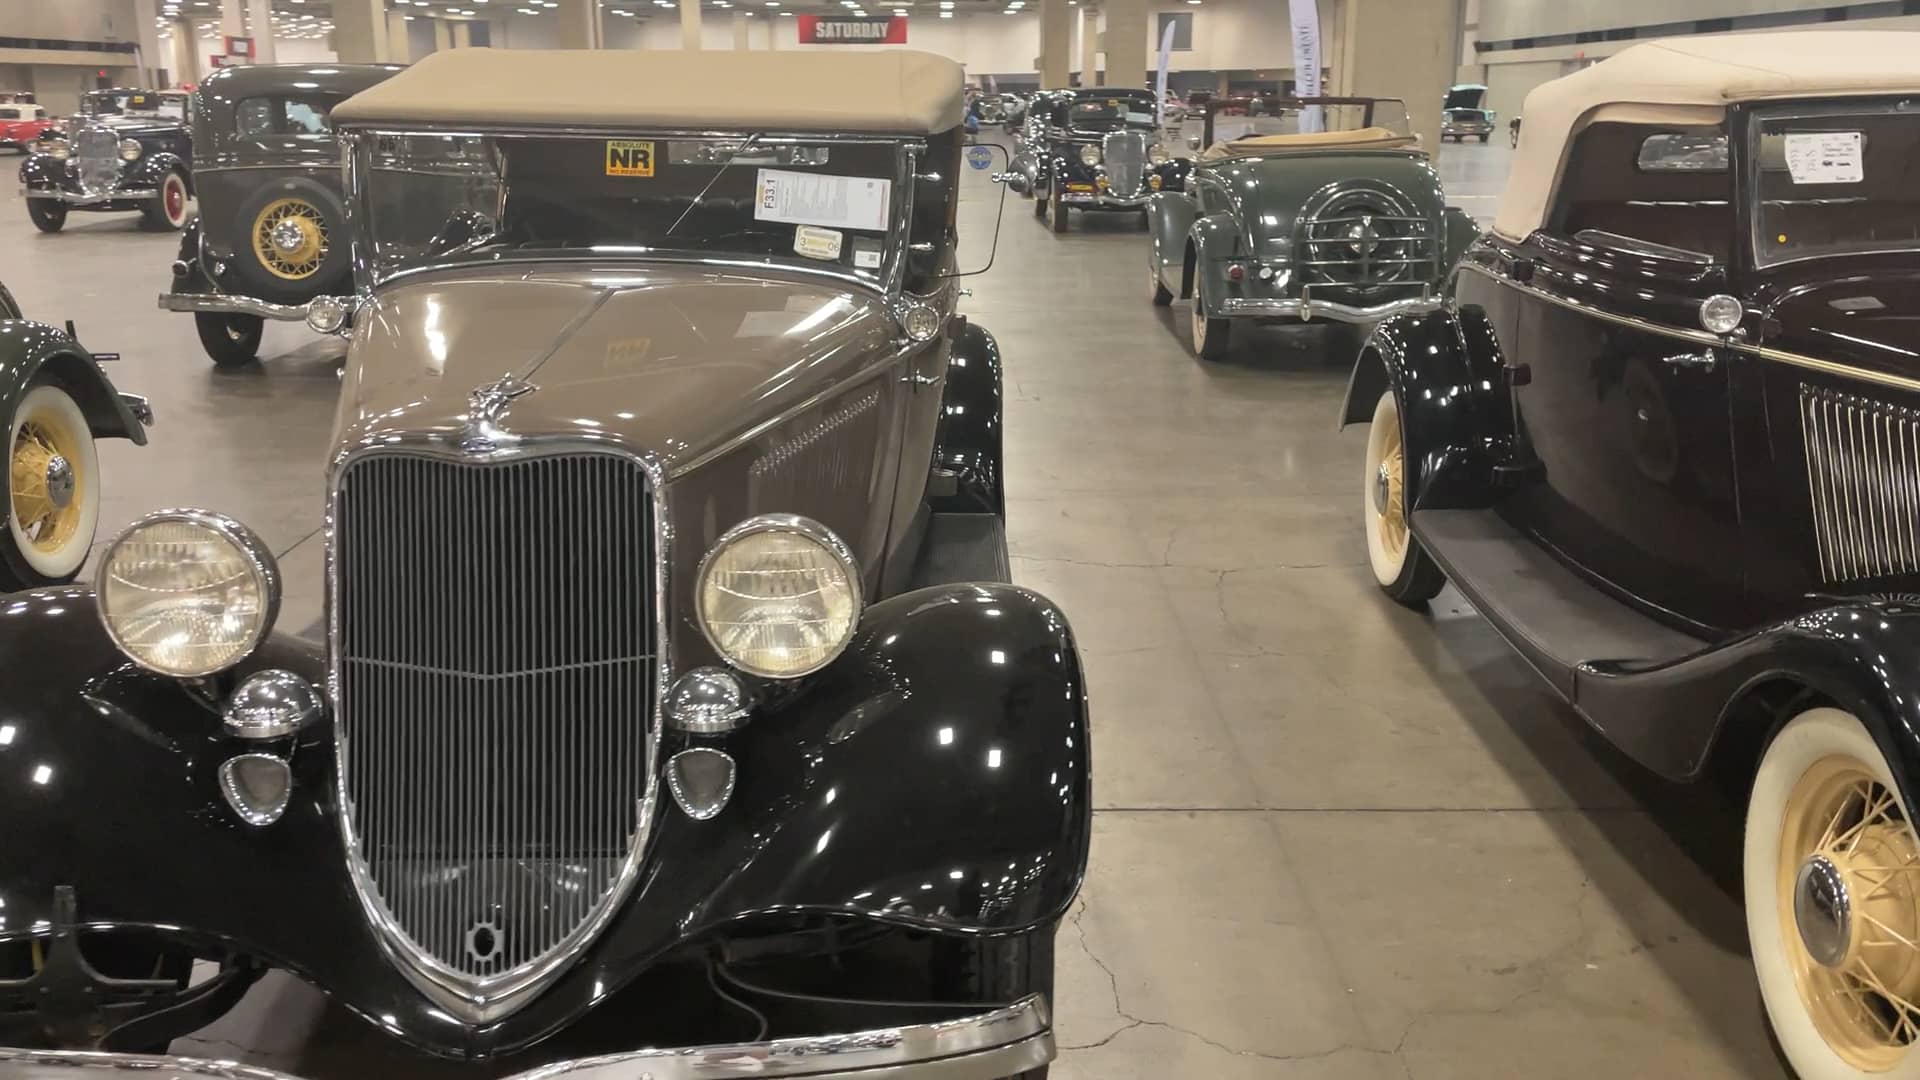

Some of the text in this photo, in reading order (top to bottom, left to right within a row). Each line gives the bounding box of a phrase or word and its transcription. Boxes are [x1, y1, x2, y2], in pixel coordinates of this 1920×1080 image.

[815, 22, 888, 38] SATURDAY
[610, 148, 650, 168] NR
[764, 179, 776, 208] F33.1
